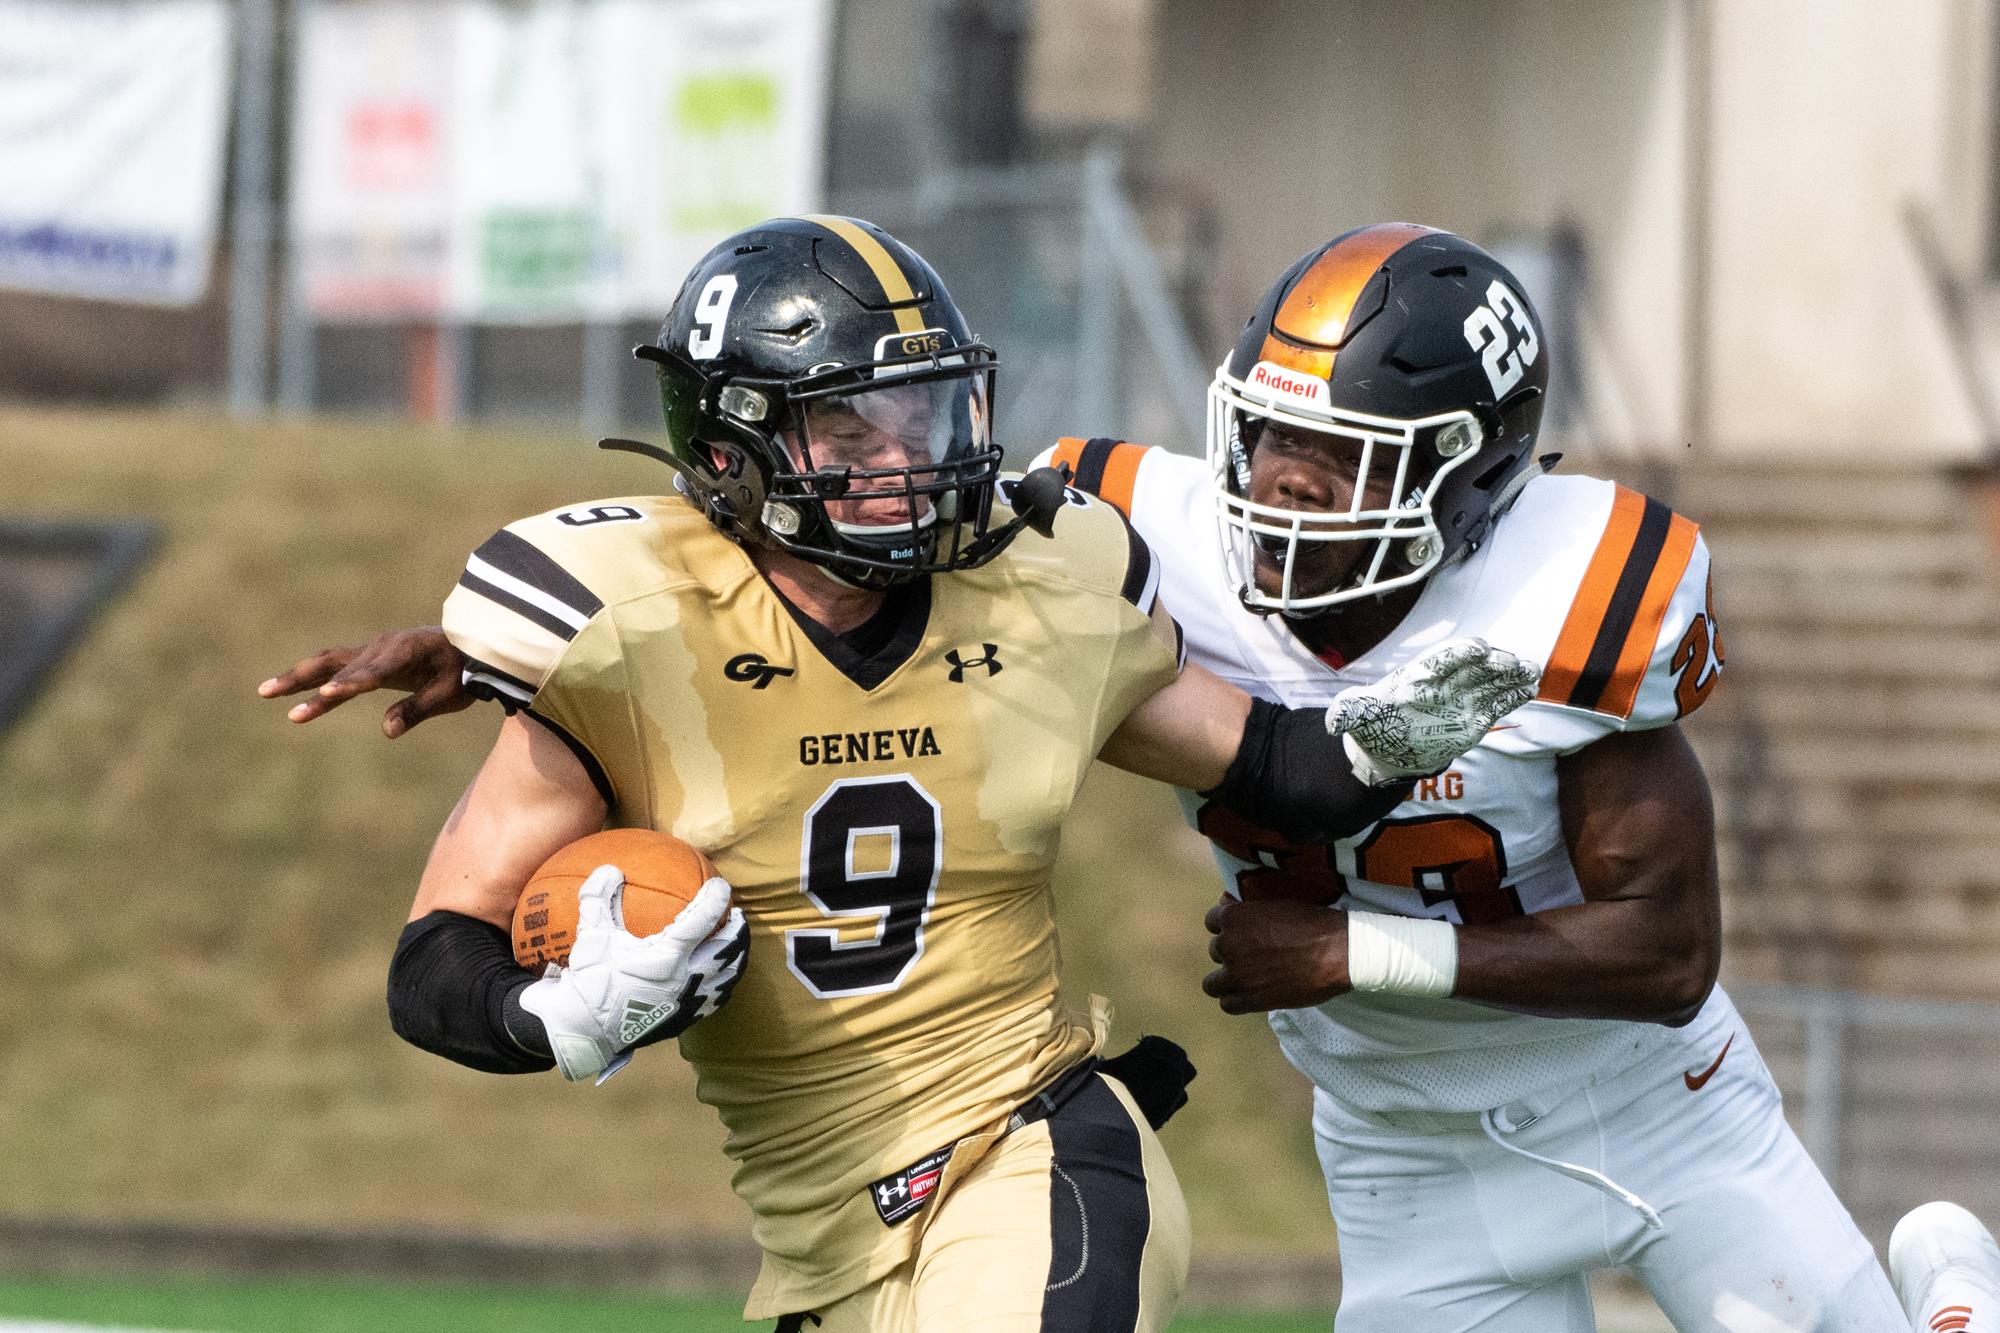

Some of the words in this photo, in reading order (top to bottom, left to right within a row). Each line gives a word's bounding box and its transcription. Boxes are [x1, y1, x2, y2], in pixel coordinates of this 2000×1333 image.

[688, 275, 739, 361] 9
[902, 335, 941, 355] GTs
[1463, 279, 1539, 402] 23
[1255, 366, 1318, 399] Riddell
[724, 654, 795, 690] GT
[799, 726, 942, 765] GENEVA
[1403, 770, 1465, 802] RG
[785, 773, 943, 1000] 9
[623, 1003, 672, 1042] adidas
[910, 1158, 935, 1175] UNDER
